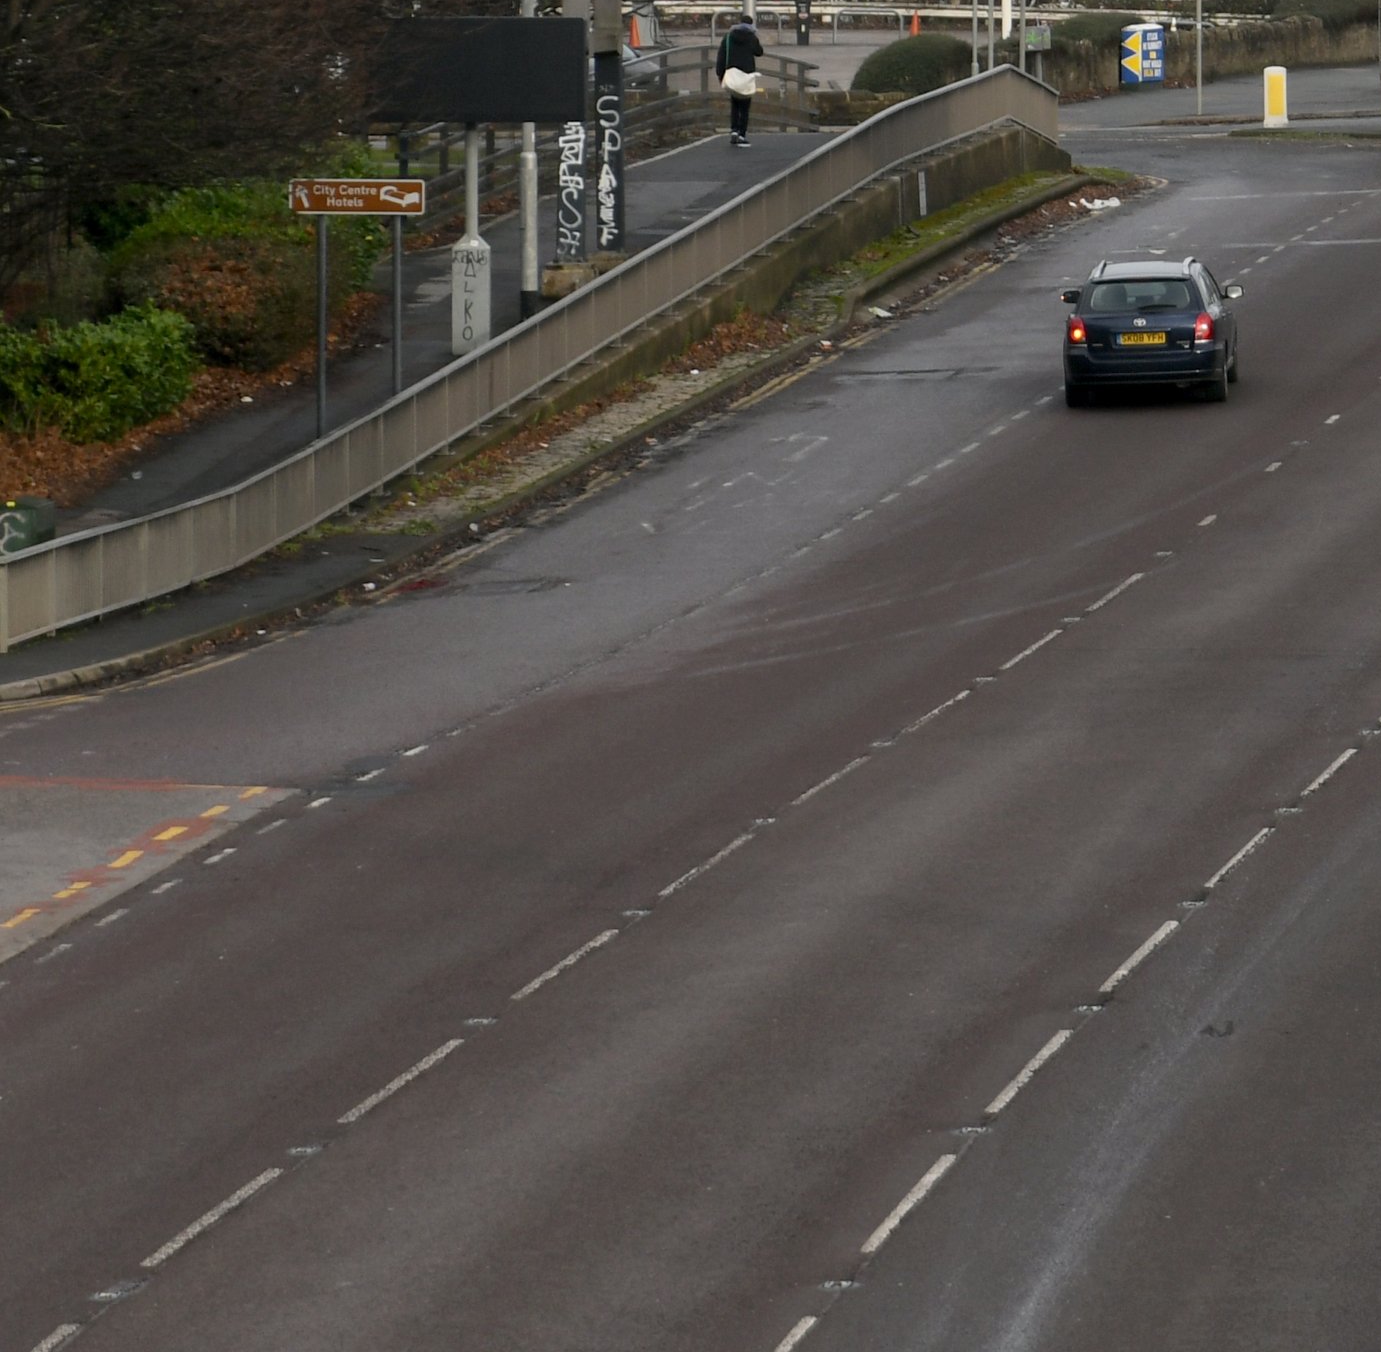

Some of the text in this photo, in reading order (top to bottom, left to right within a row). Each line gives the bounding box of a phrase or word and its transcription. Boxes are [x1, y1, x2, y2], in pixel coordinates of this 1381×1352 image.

[312, 185, 377, 196] City Centre
[326, 198, 364, 207] Hotels
[1147, 332, 1164, 343] YFH
